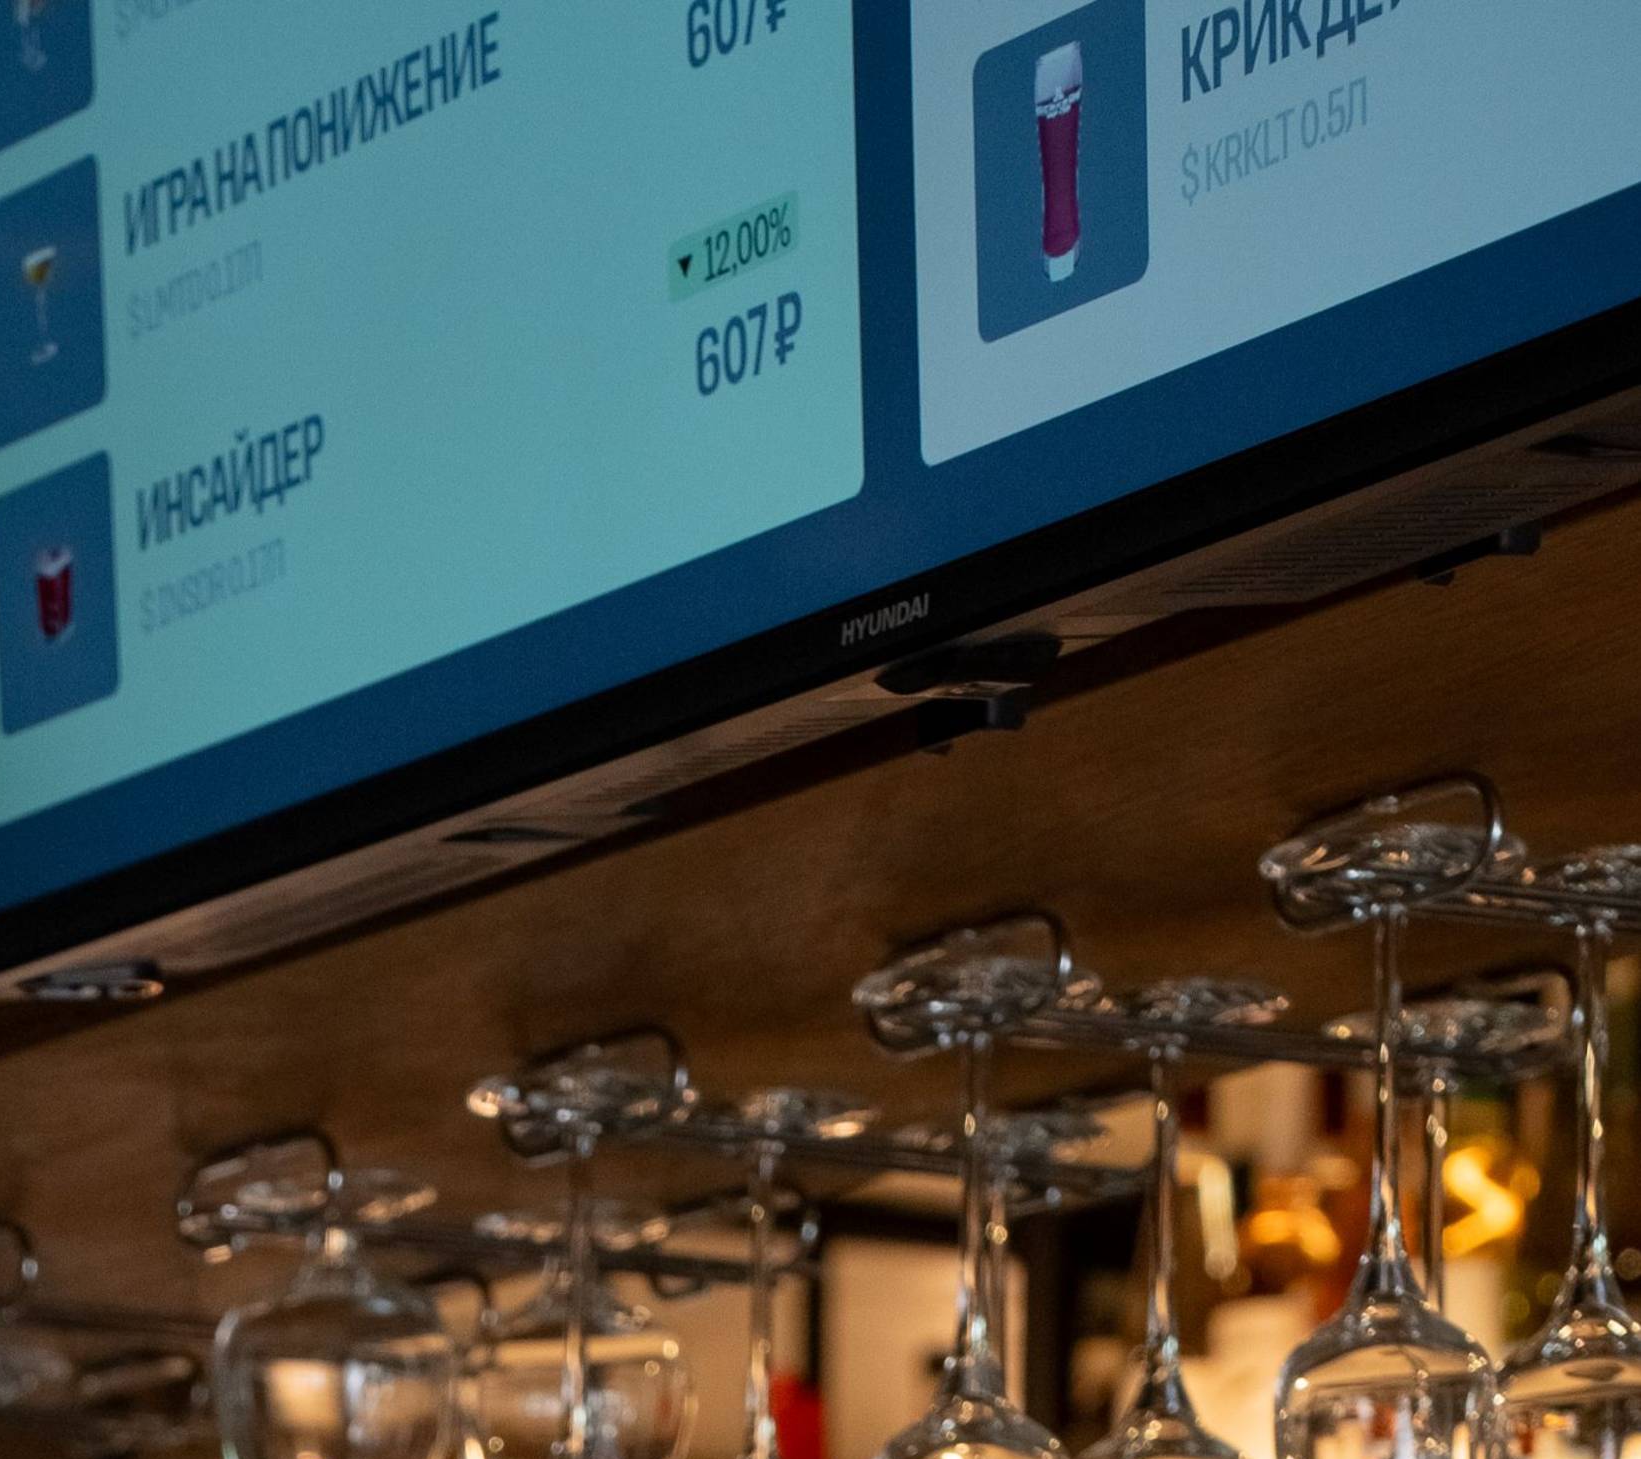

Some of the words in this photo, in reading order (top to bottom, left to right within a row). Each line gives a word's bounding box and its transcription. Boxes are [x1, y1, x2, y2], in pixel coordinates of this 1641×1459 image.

[1181, 0, 1311, 103] КРИК
[124, 157, 213, 257] ИГРА
[215, 132, 263, 213] НА
[266, 10, 501, 189] ПОНИЖЕНИЕ
[702, 202, 792, 283] 12,00%
[695, 290, 803, 397] 607₽
[135, 413, 325, 551] ИНСАЙДЕР
[841, 592, 930, 647] HYUNDAI
